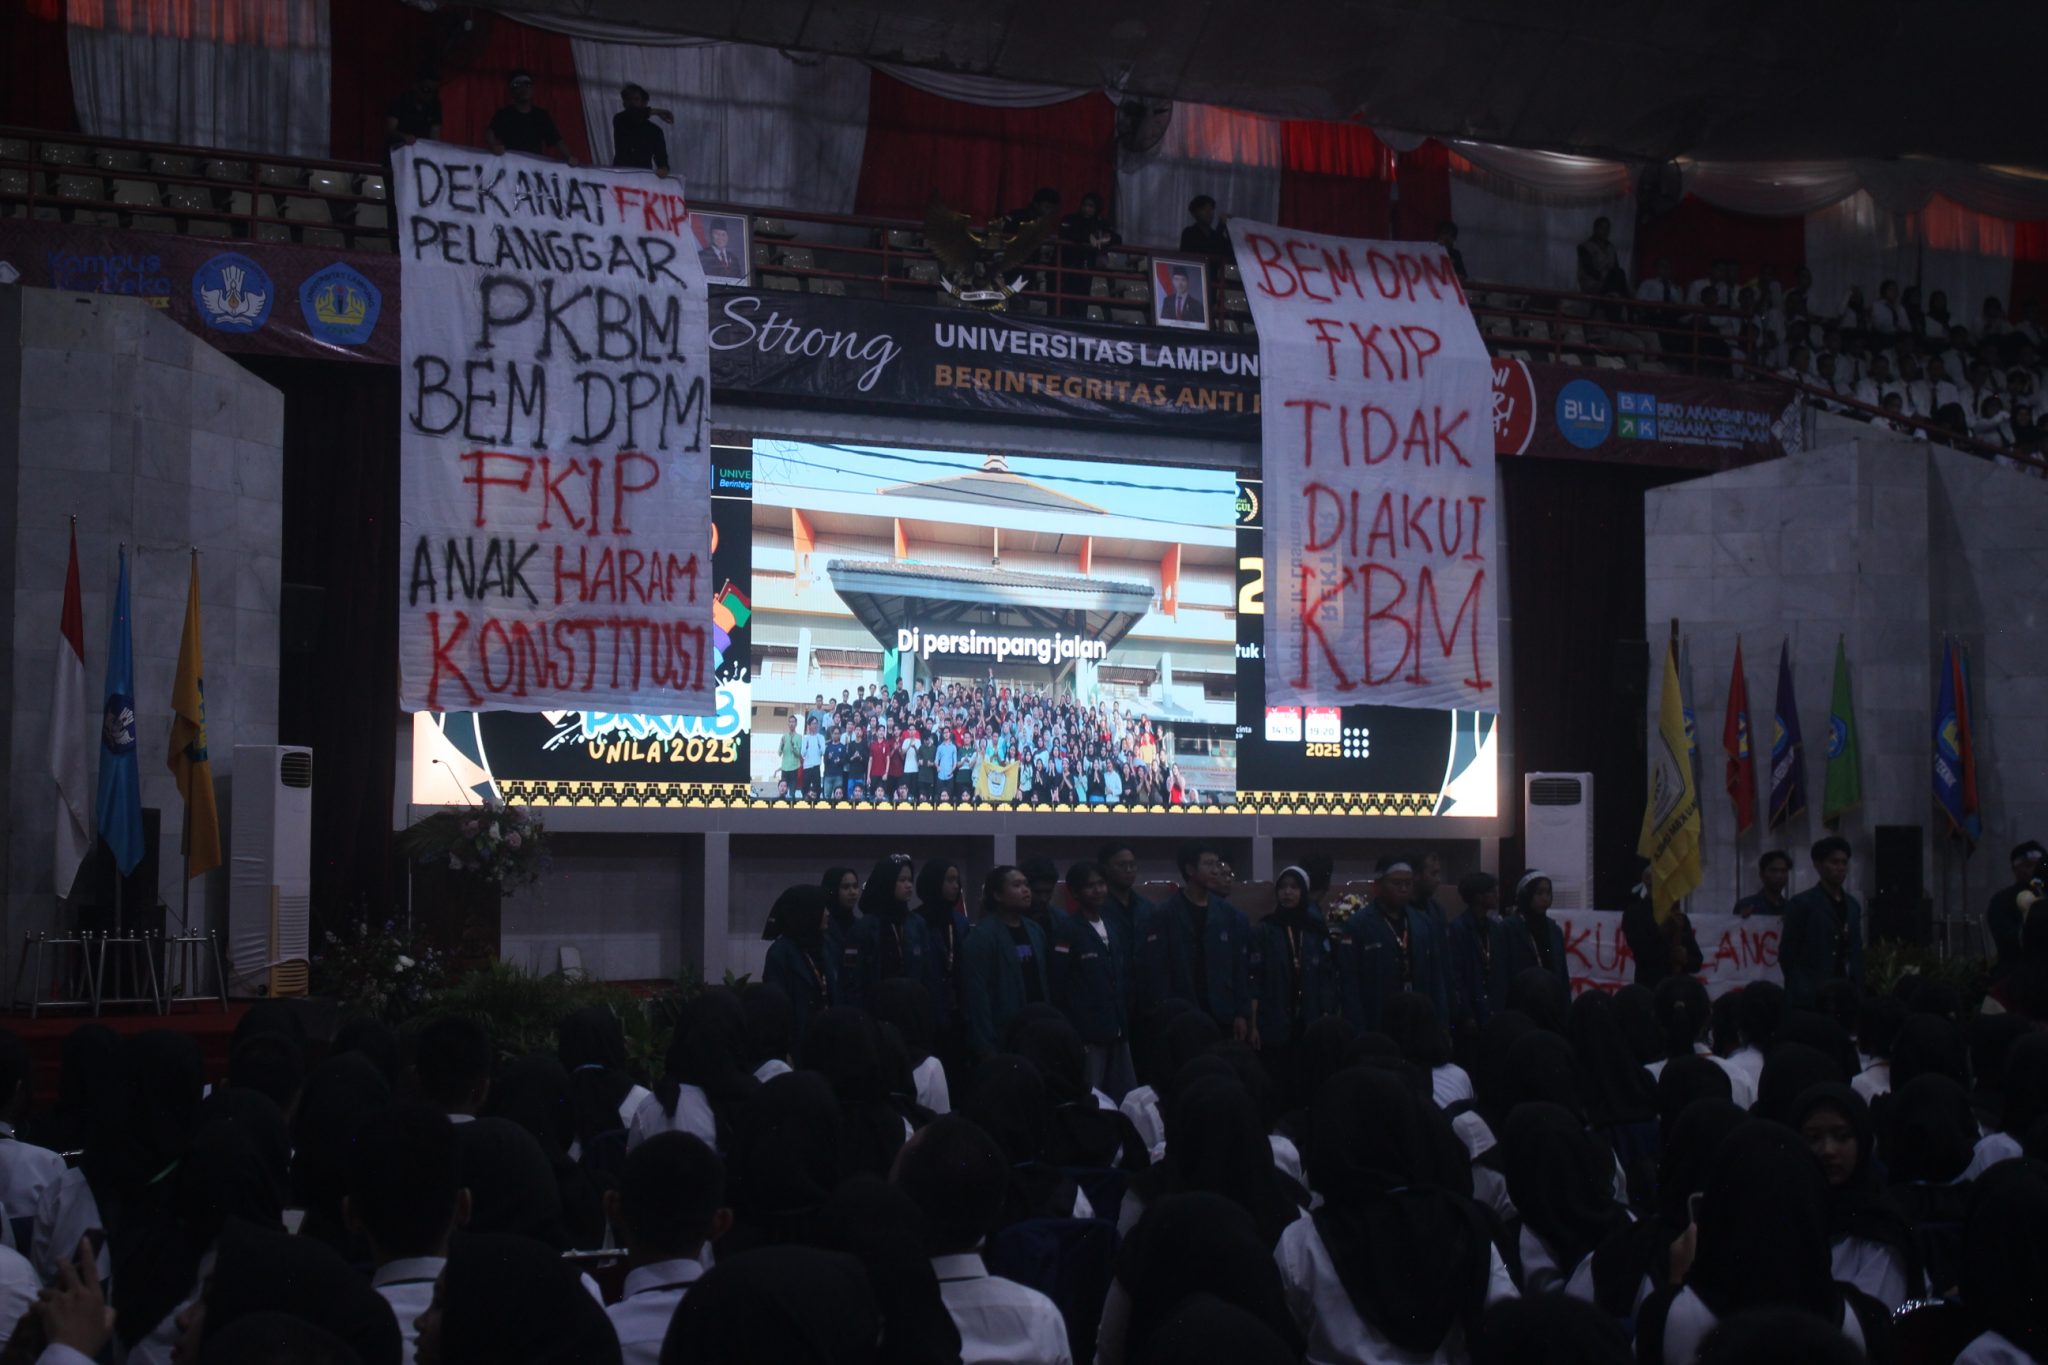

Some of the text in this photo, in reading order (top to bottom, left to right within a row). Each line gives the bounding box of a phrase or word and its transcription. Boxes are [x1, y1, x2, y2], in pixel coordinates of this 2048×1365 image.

[413, 157, 688, 237] DEKANAT FKIP
[410, 214, 688, 290] PELANGGAR
[1244, 233, 1466, 305] BEM DPM
[474, 274, 686, 363] PKBM
[709, 296, 902, 392] Strong
[934, 322, 1135, 366] UNIVERSITAS
[1306, 318, 1441, 381] FKIP
[408, 354, 706, 452] BEM DPM
[934, 363, 1168, 407] BERINTEGRITAS
[1175, 386, 1244, 414] ANTI
[1564, 399, 1605, 422] BLU
[1284, 399, 1472, 468] TIDAK
[460, 451, 660, 536] FKIP
[719, 468, 752, 480] UNIVE
[1303, 482, 1487, 560] DIAKUI
[409, 534, 698, 606] ANAK HARAM
[426, 610, 706, 711] KONSTITUSI
[897, 627, 1107, 665] Di persimpang jalan
[1290, 562, 1493, 693] KBM
[588, 738, 736, 764] UNILA 2025
[1305, 743, 1342, 757] 2025
